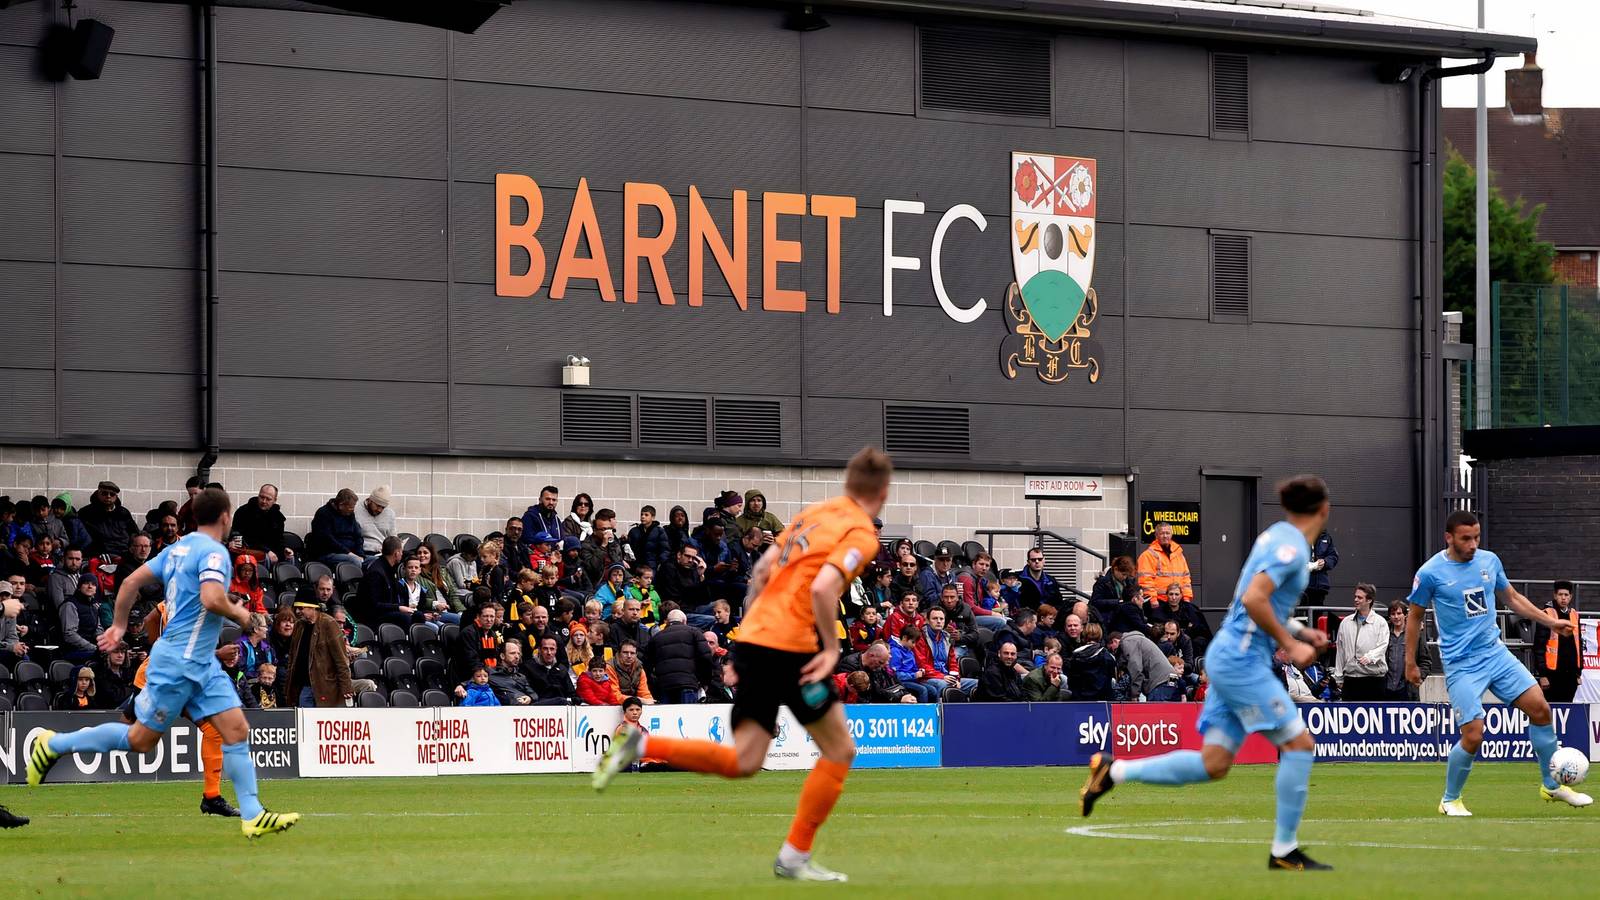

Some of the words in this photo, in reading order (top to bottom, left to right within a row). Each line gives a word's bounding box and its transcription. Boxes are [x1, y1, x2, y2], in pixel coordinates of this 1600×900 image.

[495, 173, 857, 315] BARNET
[883, 199, 988, 324] FC
[1029, 480, 1049, 490] FIRST
[1050, 481, 1062, 490] AID
[1064, 481, 1084, 491] ROOM
[1153, 511, 1199, 522] WHEELCHAIR
[1170, 524, 1189, 536] WING
[316, 720, 371, 741] TOSHIBA
[415, 719, 470, 741] TOSHIBA
[513, 718, 565, 738] TOSHIBA
[868, 718, 898, 738] 3011
[901, 718, 934, 738] 1424
[1386, 707, 1462, 735] TROPH
[1483, 706, 1571, 735] OMPY
[248, 727, 297, 745] ISSERIE
[1079, 715, 1110, 750] sky
[1116, 719, 1178, 752] sports
[249, 750, 291, 768] ICKEN
[319, 744, 375, 765] MEDICAL
[417, 742, 474, 764] MEDICAL
[515, 740, 569, 761] MEDICAL
[855, 744, 936, 756] ydalcommunications.com
[1481, 740, 1509, 758] 0207
[1512, 740, 1534, 758] 272
